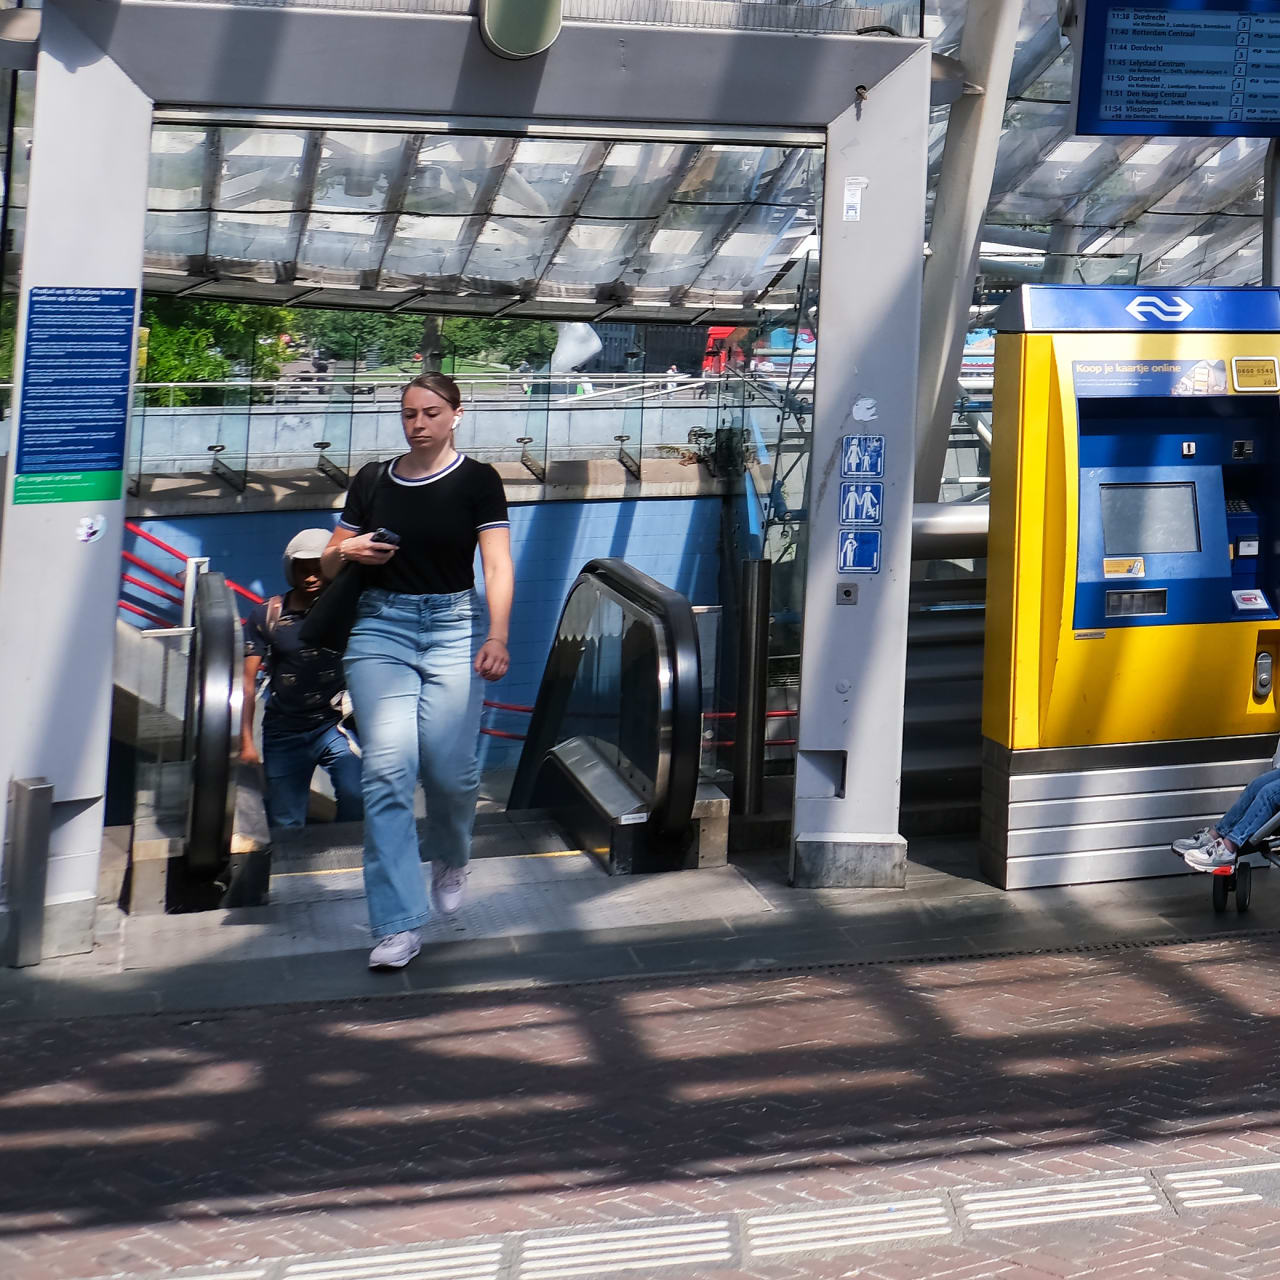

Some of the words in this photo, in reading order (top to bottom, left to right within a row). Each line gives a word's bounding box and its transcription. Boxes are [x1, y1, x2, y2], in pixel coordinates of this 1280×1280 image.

[1130, 59, 1156, 68] Lelystad
[1142, 90, 1158, 98] Haag
[1077, 364, 1102, 374] Koop
[1104, 364, 1112, 374] je
[1116, 364, 1149, 373] kaartje
[1152, 364, 1182, 372] online
